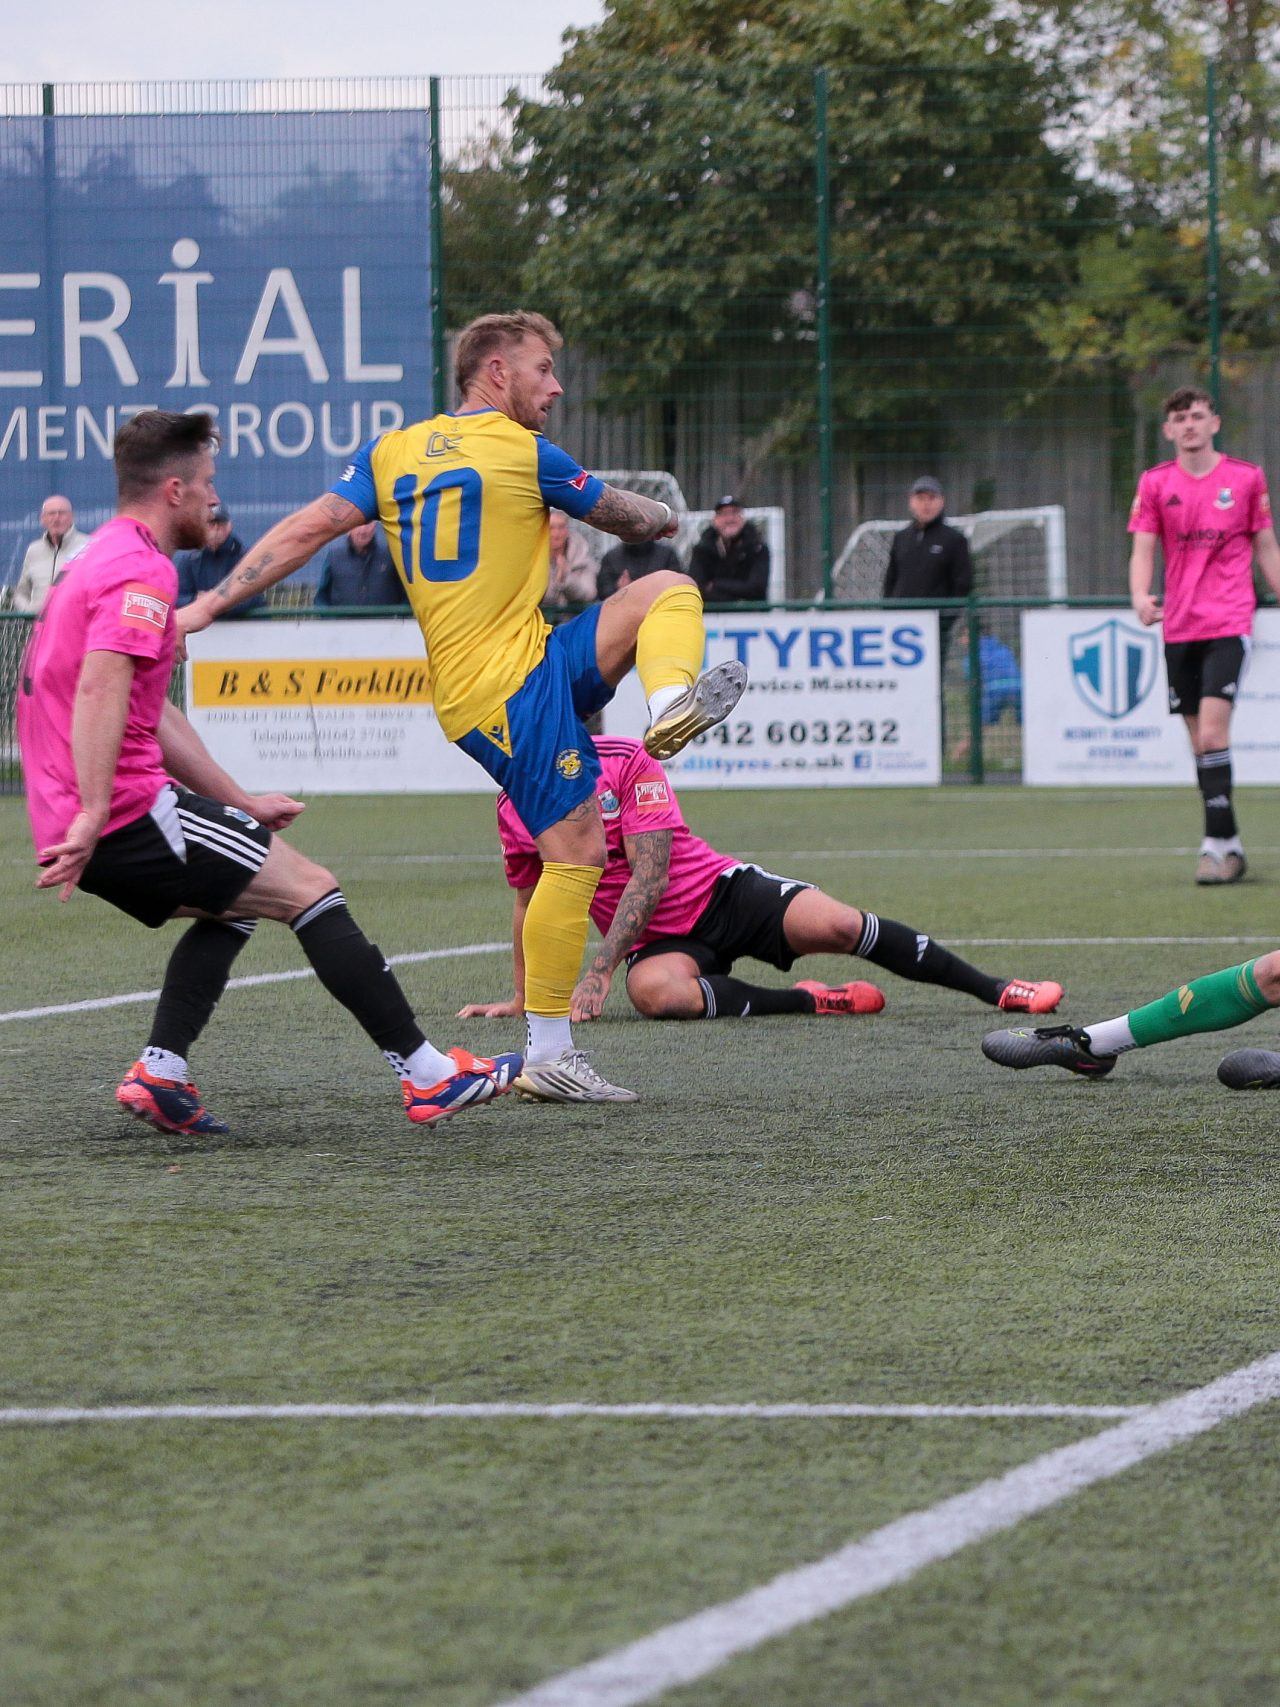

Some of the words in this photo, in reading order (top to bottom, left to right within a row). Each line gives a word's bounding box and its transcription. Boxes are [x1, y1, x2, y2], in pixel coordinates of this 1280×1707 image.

[393, 467, 482, 584] 10
[218, 668, 240, 698] B
[250, 667, 272, 698] &
[283, 668, 306, 698] S
[811, 678, 898, 692] Matters
[767, 719, 900, 746] 603232
